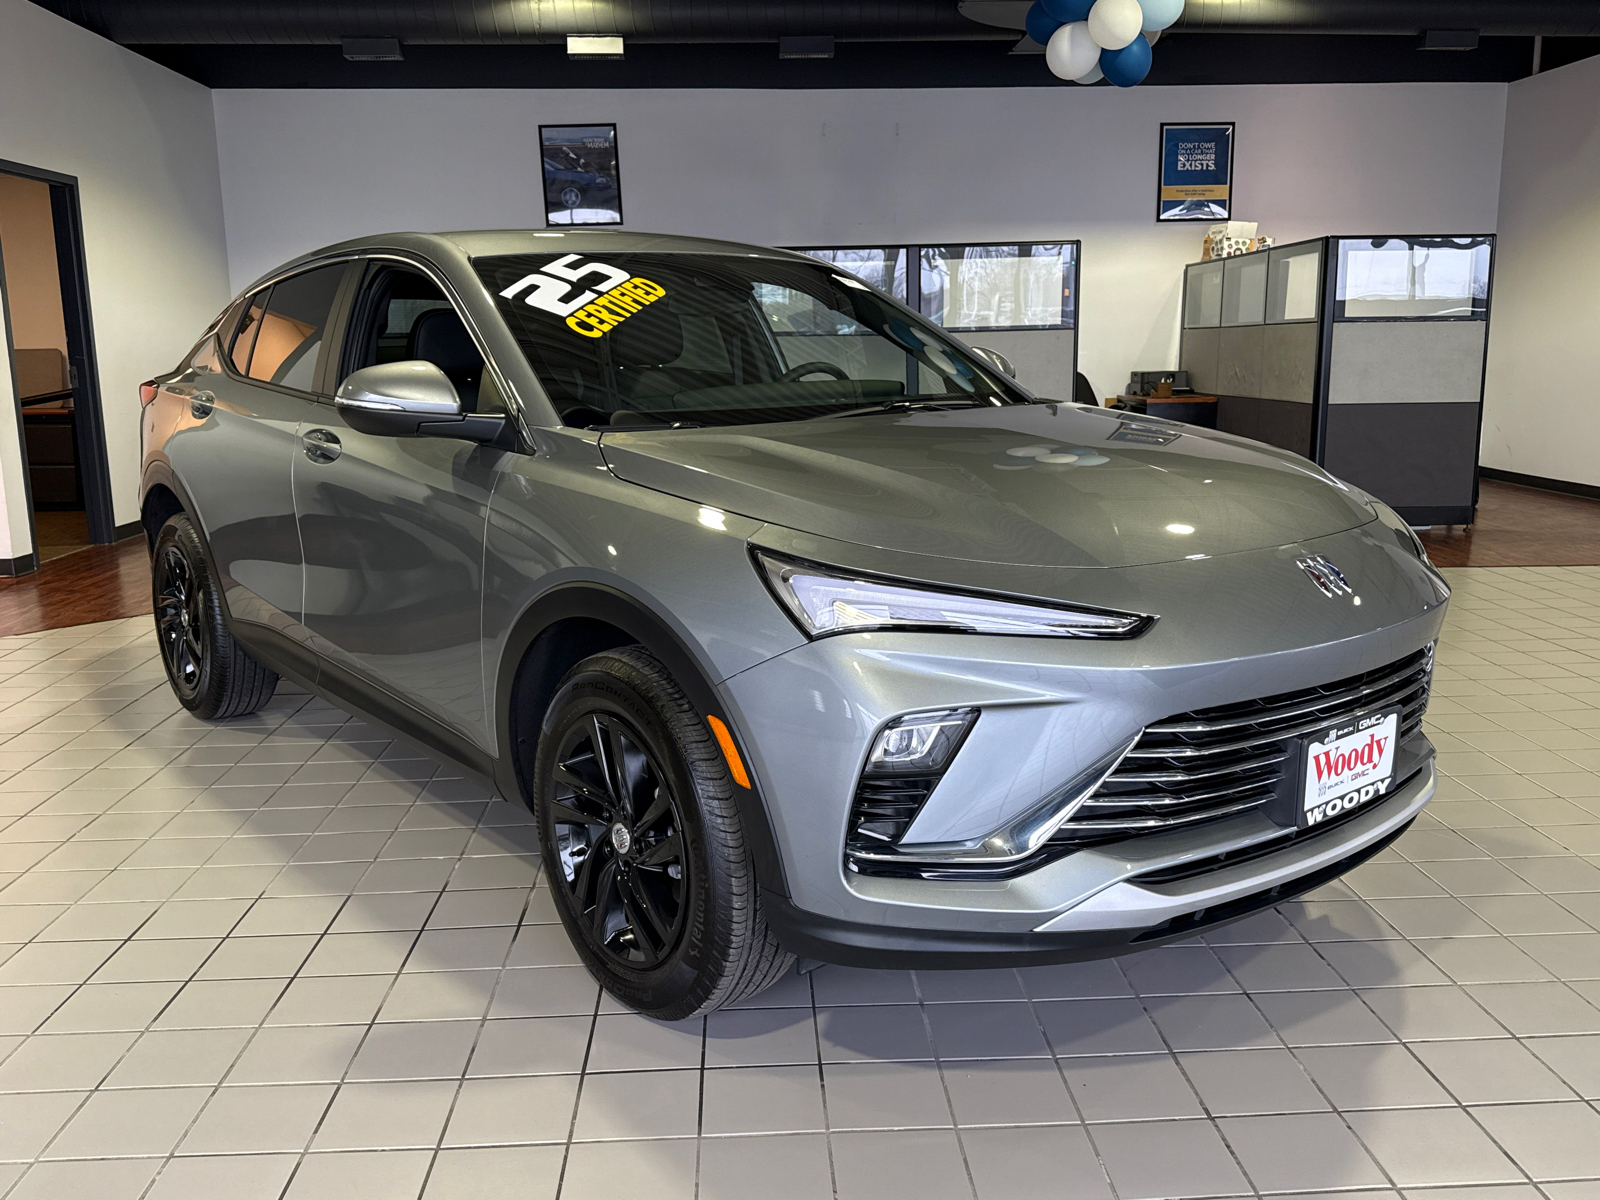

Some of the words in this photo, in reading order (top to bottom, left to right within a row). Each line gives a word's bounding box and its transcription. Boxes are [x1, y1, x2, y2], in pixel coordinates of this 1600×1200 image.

[1178, 160, 1216, 170] EXISTS.
[499, 253, 631, 317] 25
[565, 277, 667, 338] CERTIFIED
[1337, 726, 1354, 736] BUICK
[1358, 714, 1382, 730] GMC
[1313, 733, 1389, 784] Woody
[1327, 779, 1345, 790] BUICK
[1351, 768, 1370, 781] GMC
[1306, 777, 1392, 826] WOODY
